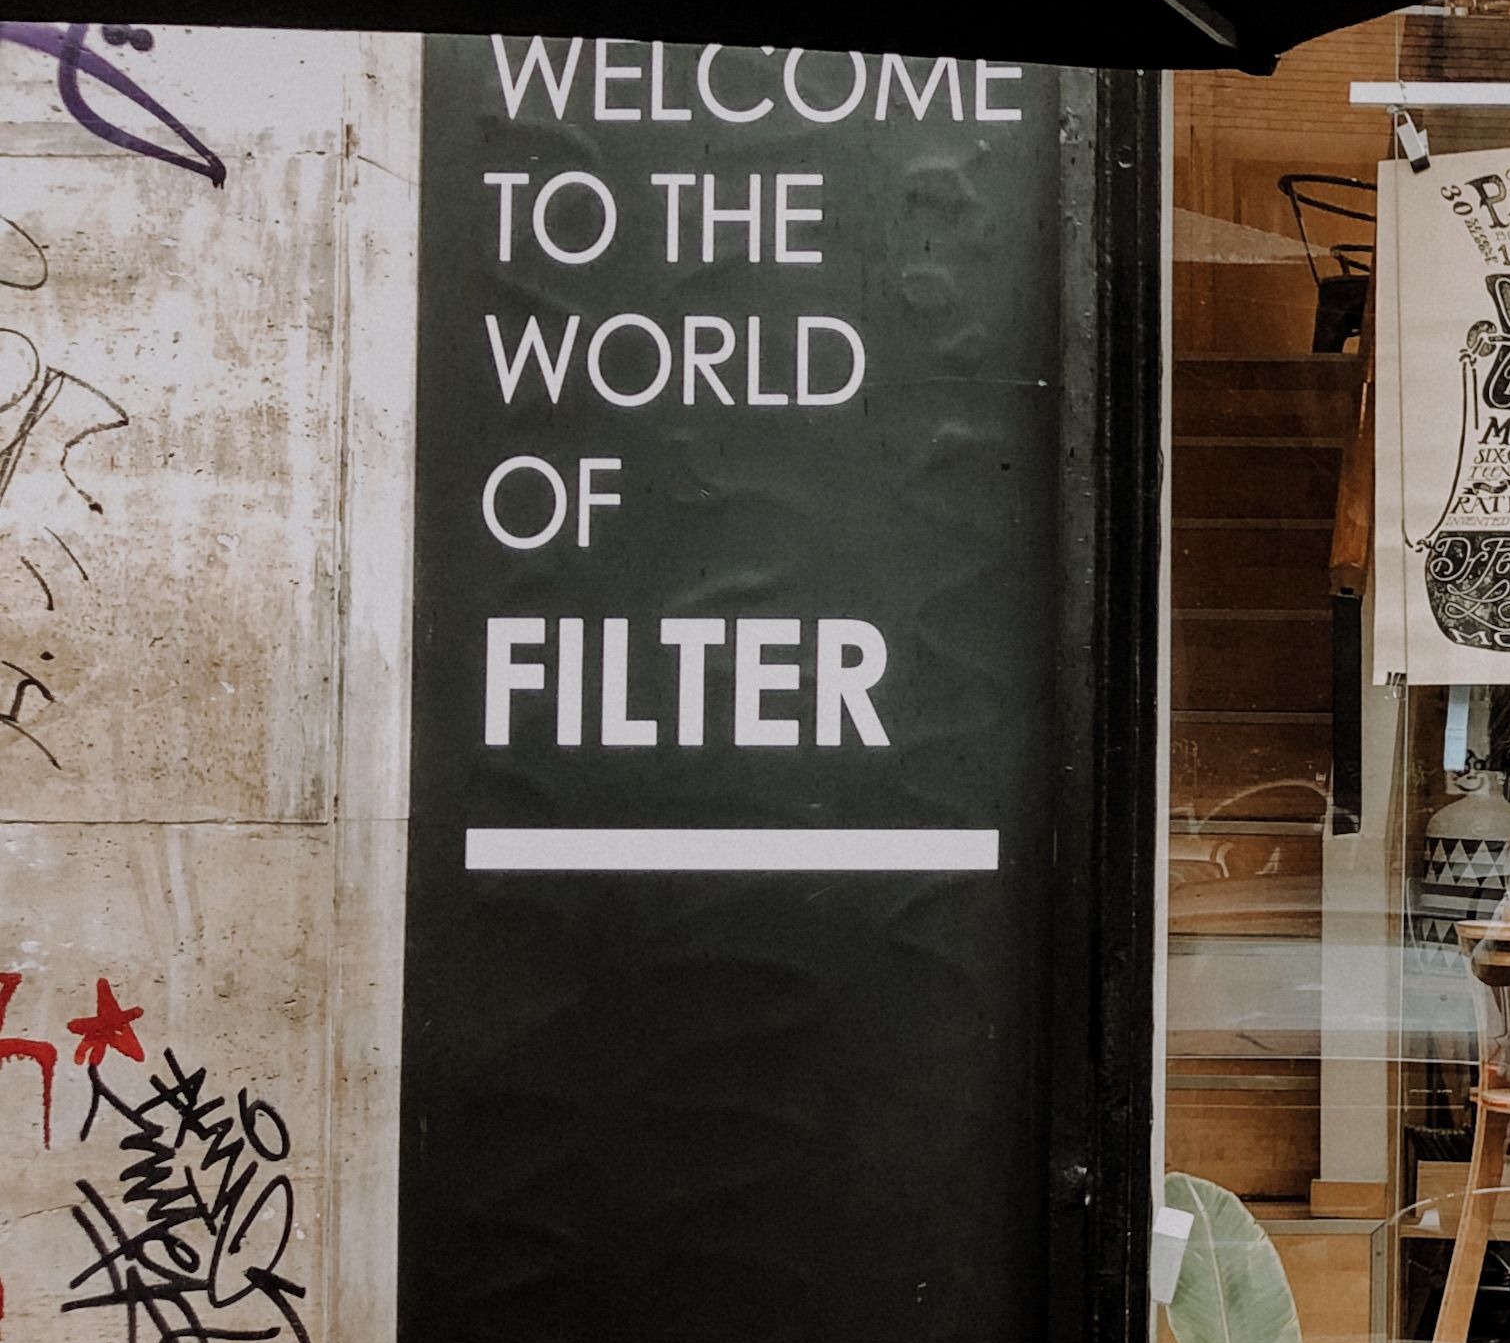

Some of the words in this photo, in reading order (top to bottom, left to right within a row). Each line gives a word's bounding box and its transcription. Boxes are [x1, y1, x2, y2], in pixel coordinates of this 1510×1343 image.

[491, 34, 1023, 121] WELCOME
[484, 171, 617, 264] TO
[651, 173, 823, 264] THE
[1440, 184, 1473, 216] 30
[485, 313, 867, 407] WORLD
[482, 455, 622, 550] OF
[484, 617, 890, 746] FILTER
